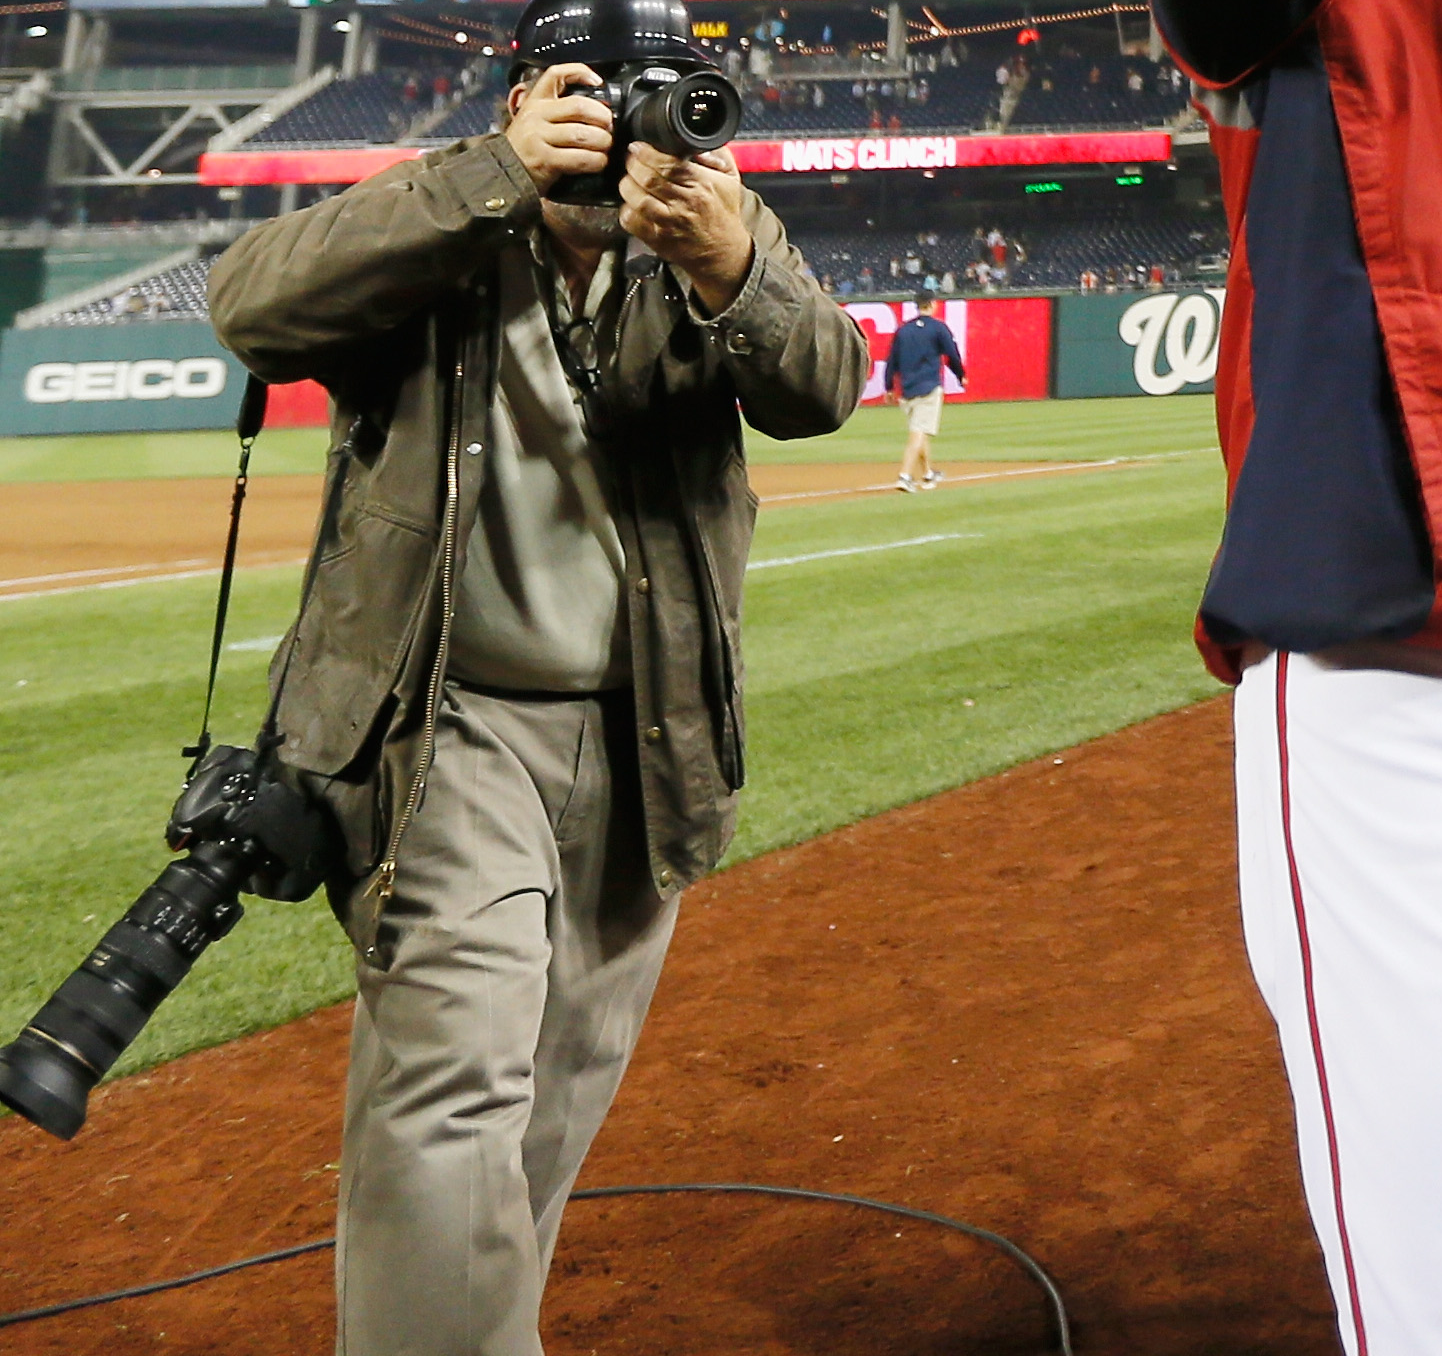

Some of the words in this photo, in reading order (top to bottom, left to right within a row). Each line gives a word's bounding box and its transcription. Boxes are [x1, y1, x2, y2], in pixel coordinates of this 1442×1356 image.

[646, 70, 678, 83] Nikon
[782, 138, 854, 171] NATS
[857, 137, 956, 169] CLINCH
[22, 358, 229, 403] GEICO
